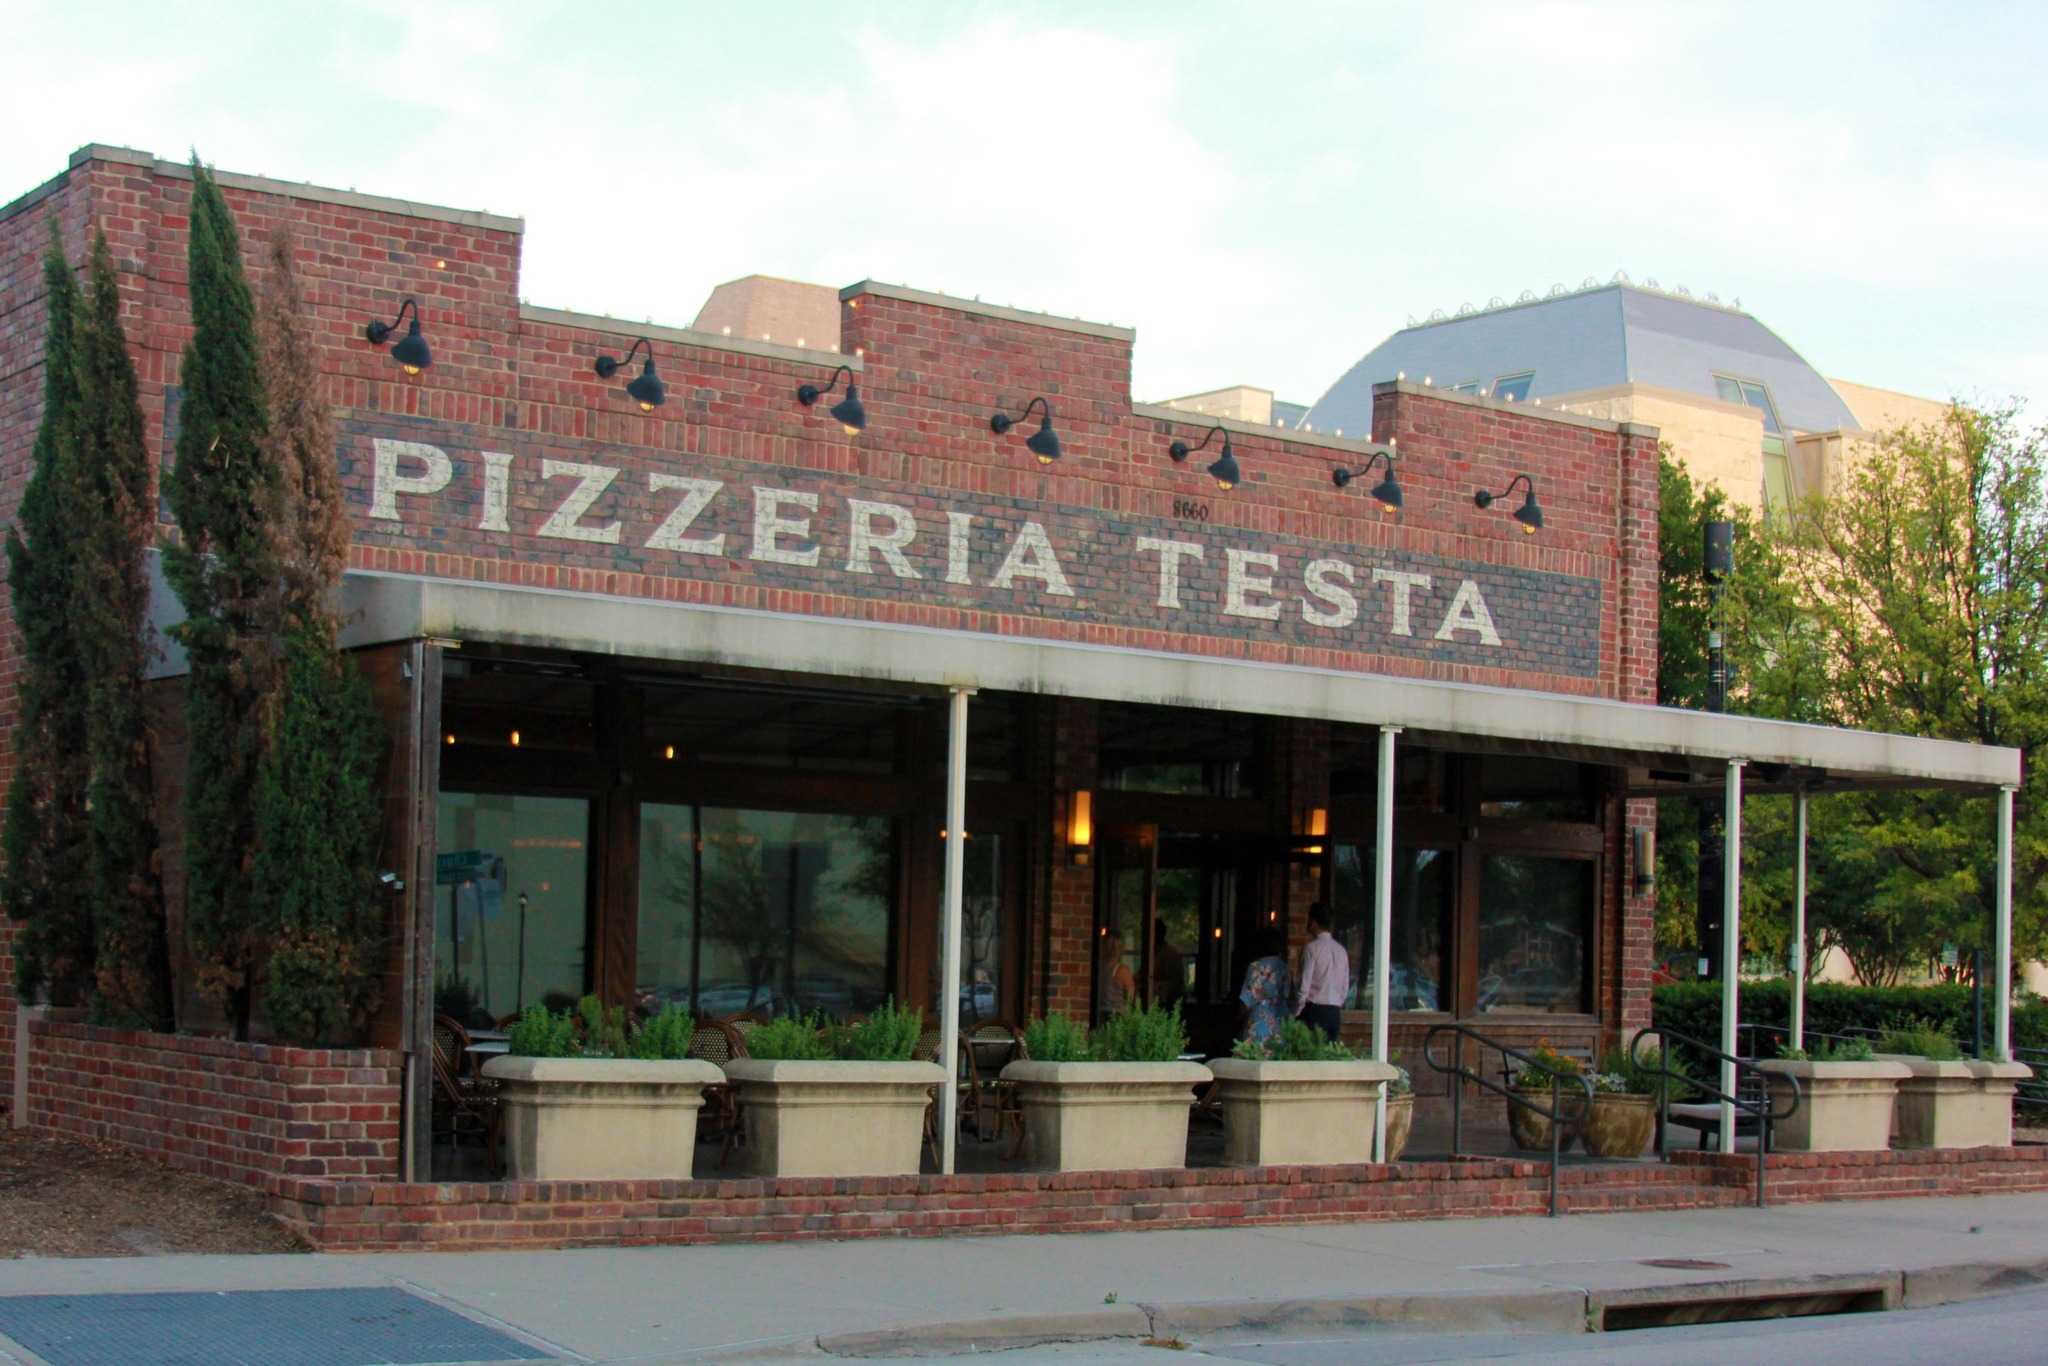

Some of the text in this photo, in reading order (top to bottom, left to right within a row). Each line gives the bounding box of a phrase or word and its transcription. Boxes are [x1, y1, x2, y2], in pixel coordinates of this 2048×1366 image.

[369, 438, 1502, 646] PIZZERIA TESTA
[1173, 500, 1208, 521] 8660
